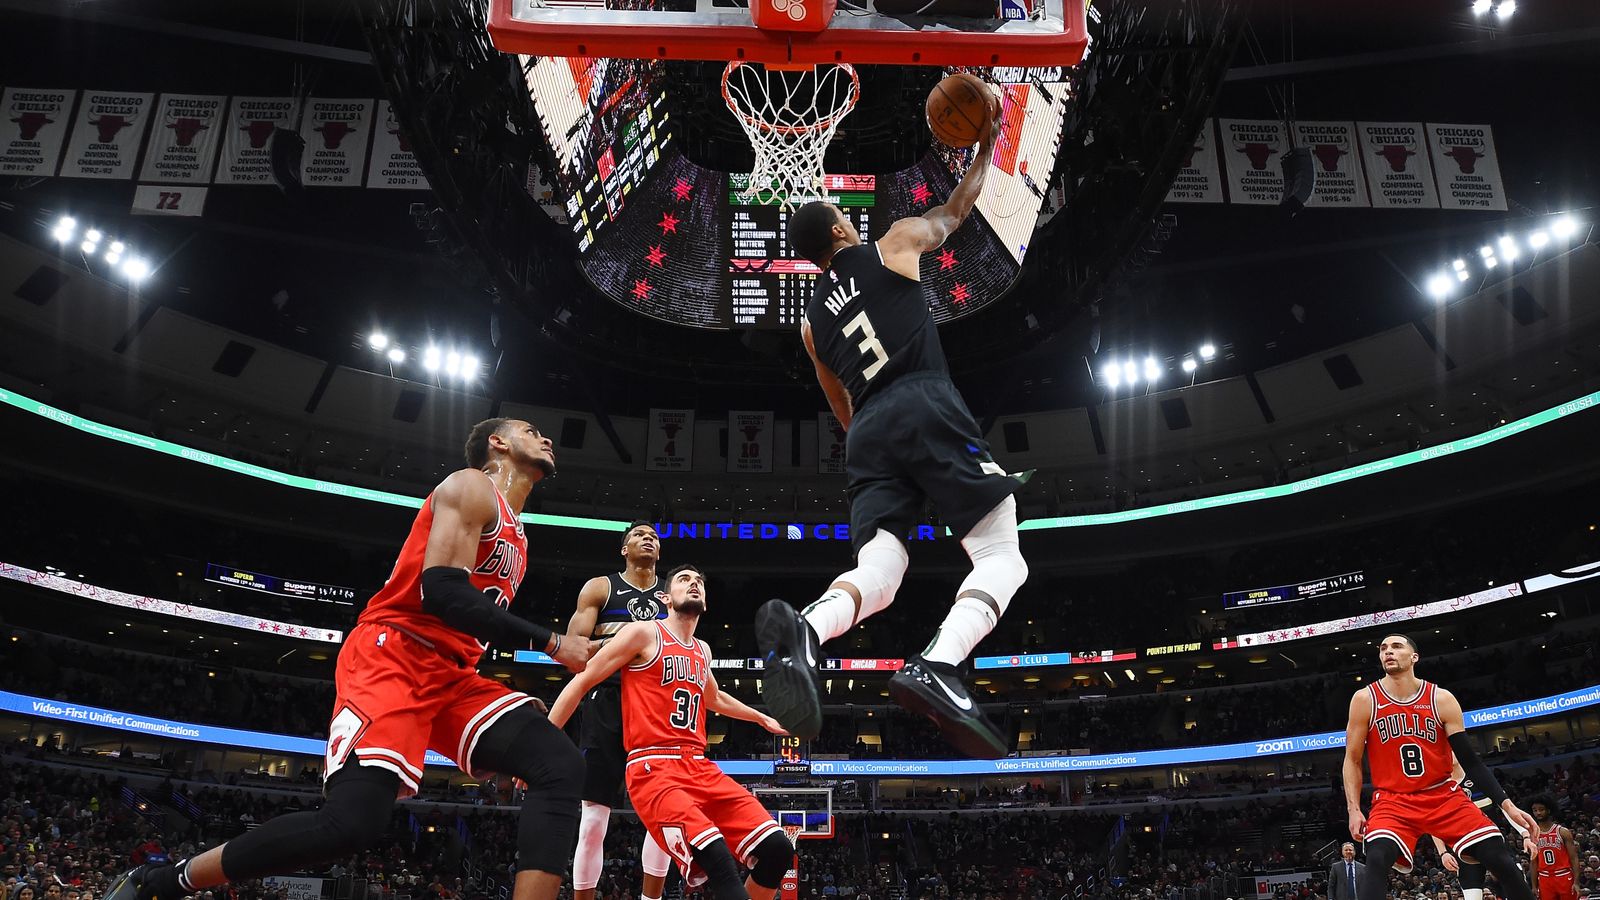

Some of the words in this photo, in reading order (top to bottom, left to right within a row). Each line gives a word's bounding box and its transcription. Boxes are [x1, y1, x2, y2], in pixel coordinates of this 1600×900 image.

[1005, 8, 1022, 19] NBA
[12, 93, 65, 103] CHICAGO
[91, 95, 143, 106] CHICAGO
[17, 103, 56, 112] BULLS
[168, 98, 218, 109] CHICAGO
[239, 101, 291, 111] CHICAGO
[314, 103, 364, 112] CHICAGO
[96, 105, 133, 114] BULLS
[173, 109, 210, 118] BULLS
[246, 111, 283, 120] BULLS
[320, 112, 356, 121] BULLS
[1229, 123, 1279, 133] CHICAGO
[1298, 125, 1347, 136] CHICAGO
[1366, 127, 1415, 136] CHICAGO
[1436, 128, 1484, 138] CHICAGO
[1238, 133, 1274, 142] BULLS
[1308, 135, 1342, 144] BULLS
[1377, 135, 1410, 144] BULLS
[1445, 137, 1479, 146] BULLS
[10, 141, 41, 149] CENTRAL
[88, 143, 119, 151] CENTRAL
[167, 146, 197, 154] CENTRAL
[84, 151, 118, 159] DIVISION
[163, 154, 197, 162] DIVISION
[315, 150, 345, 158] CENTRAL
[77, 159, 121, 167] CHAMPIONS
[155, 162, 199, 171] CHAMPIONS
[312, 158, 345, 166] DIVISION
[1452, 191, 1493, 199] CHAMPIONS
[156, 192, 182, 210] 72
[824, 277, 861, 316] HILL
[842, 310, 890, 381] 3
[1566, 397, 1593, 413] RUSH
[46, 407, 73, 424] RUSH
[664, 440, 676, 456] 4
[741, 442, 759, 458] 10
[1429, 444, 1455, 458] RUSH
[190, 450, 215, 464] RUSH
[1299, 478, 1321, 490] RUSH
[656, 523, 779, 540] UNITED
[283, 582, 316, 591] SuperM
[1297, 581, 1327, 592] SuperM
[1146, 647, 1167, 656] POINTS
[1167, 645, 1174, 654] IN
[1174, 644, 1185, 653] THE
[1184, 642, 1202, 652] PAINT
[826, 660, 836, 669] 54
[851, 659, 877, 669] CHICAGO
[1025, 655, 1049, 665] CLUB
[670, 687, 701, 734] 31
[1471, 706, 1523, 723] Video-First
[1523, 699, 1557, 716] Unified
[32, 701, 88, 720] Video-First
[89, 711, 123, 726] Unified
[124, 716, 200, 738] Communications
[1374, 712, 1437, 744] BULLS
[782, 737, 800, 747] 11.3
[1256, 739, 1293, 754] zoom
[1302, 736, 1326, 747] Video
[995, 758, 1038, 771] Video-First
[1039, 757, 1070, 770] Unified
[1070, 755, 1137, 768] Communications
[1399, 743, 1425, 777] 8
[842, 763, 864, 773] Video
[865, 763, 928, 773] Communications
[1543, 849, 1555, 866] 0
[280, 880, 312, 893] Advocate
